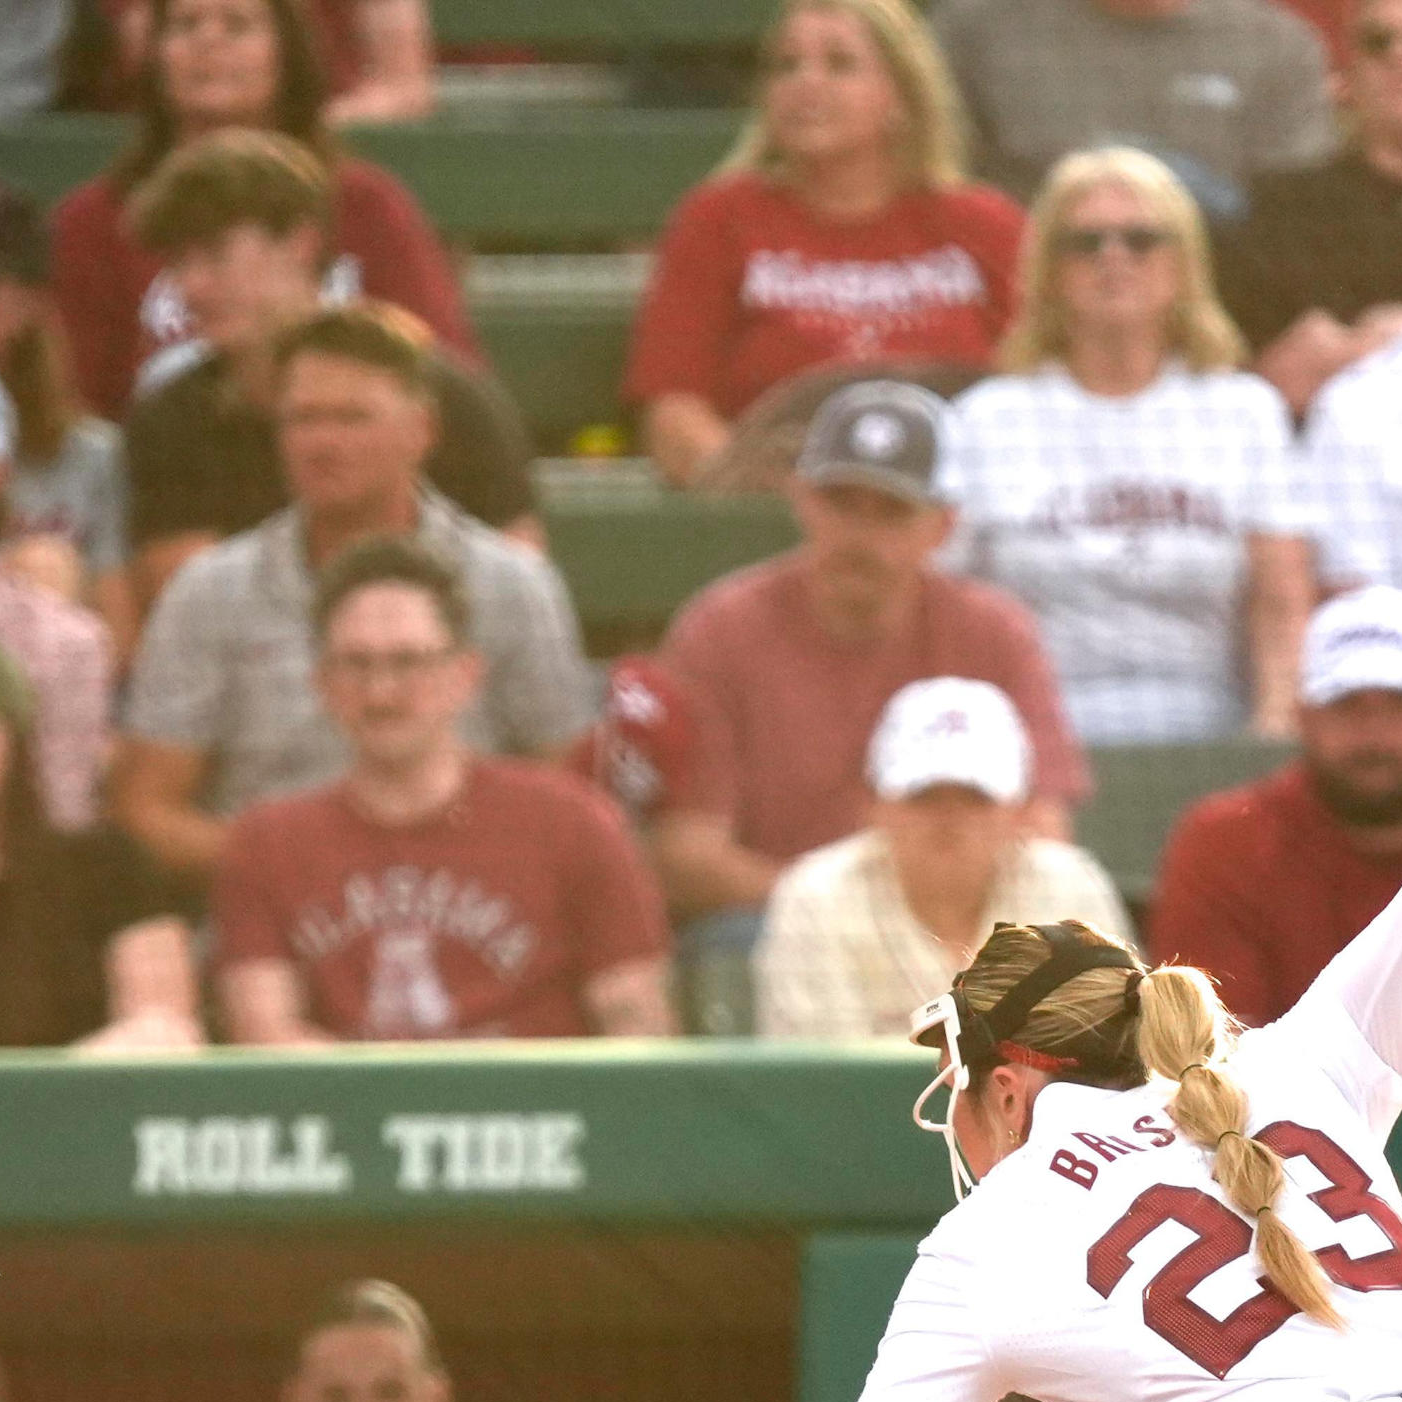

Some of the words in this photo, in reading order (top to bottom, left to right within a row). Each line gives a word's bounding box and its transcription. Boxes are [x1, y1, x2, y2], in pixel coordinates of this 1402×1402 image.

[135, 1116, 350, 1194] ROLL
[383, 1113, 584, 1191] TIDE
[1050, 1105, 1177, 1191] BRIS
